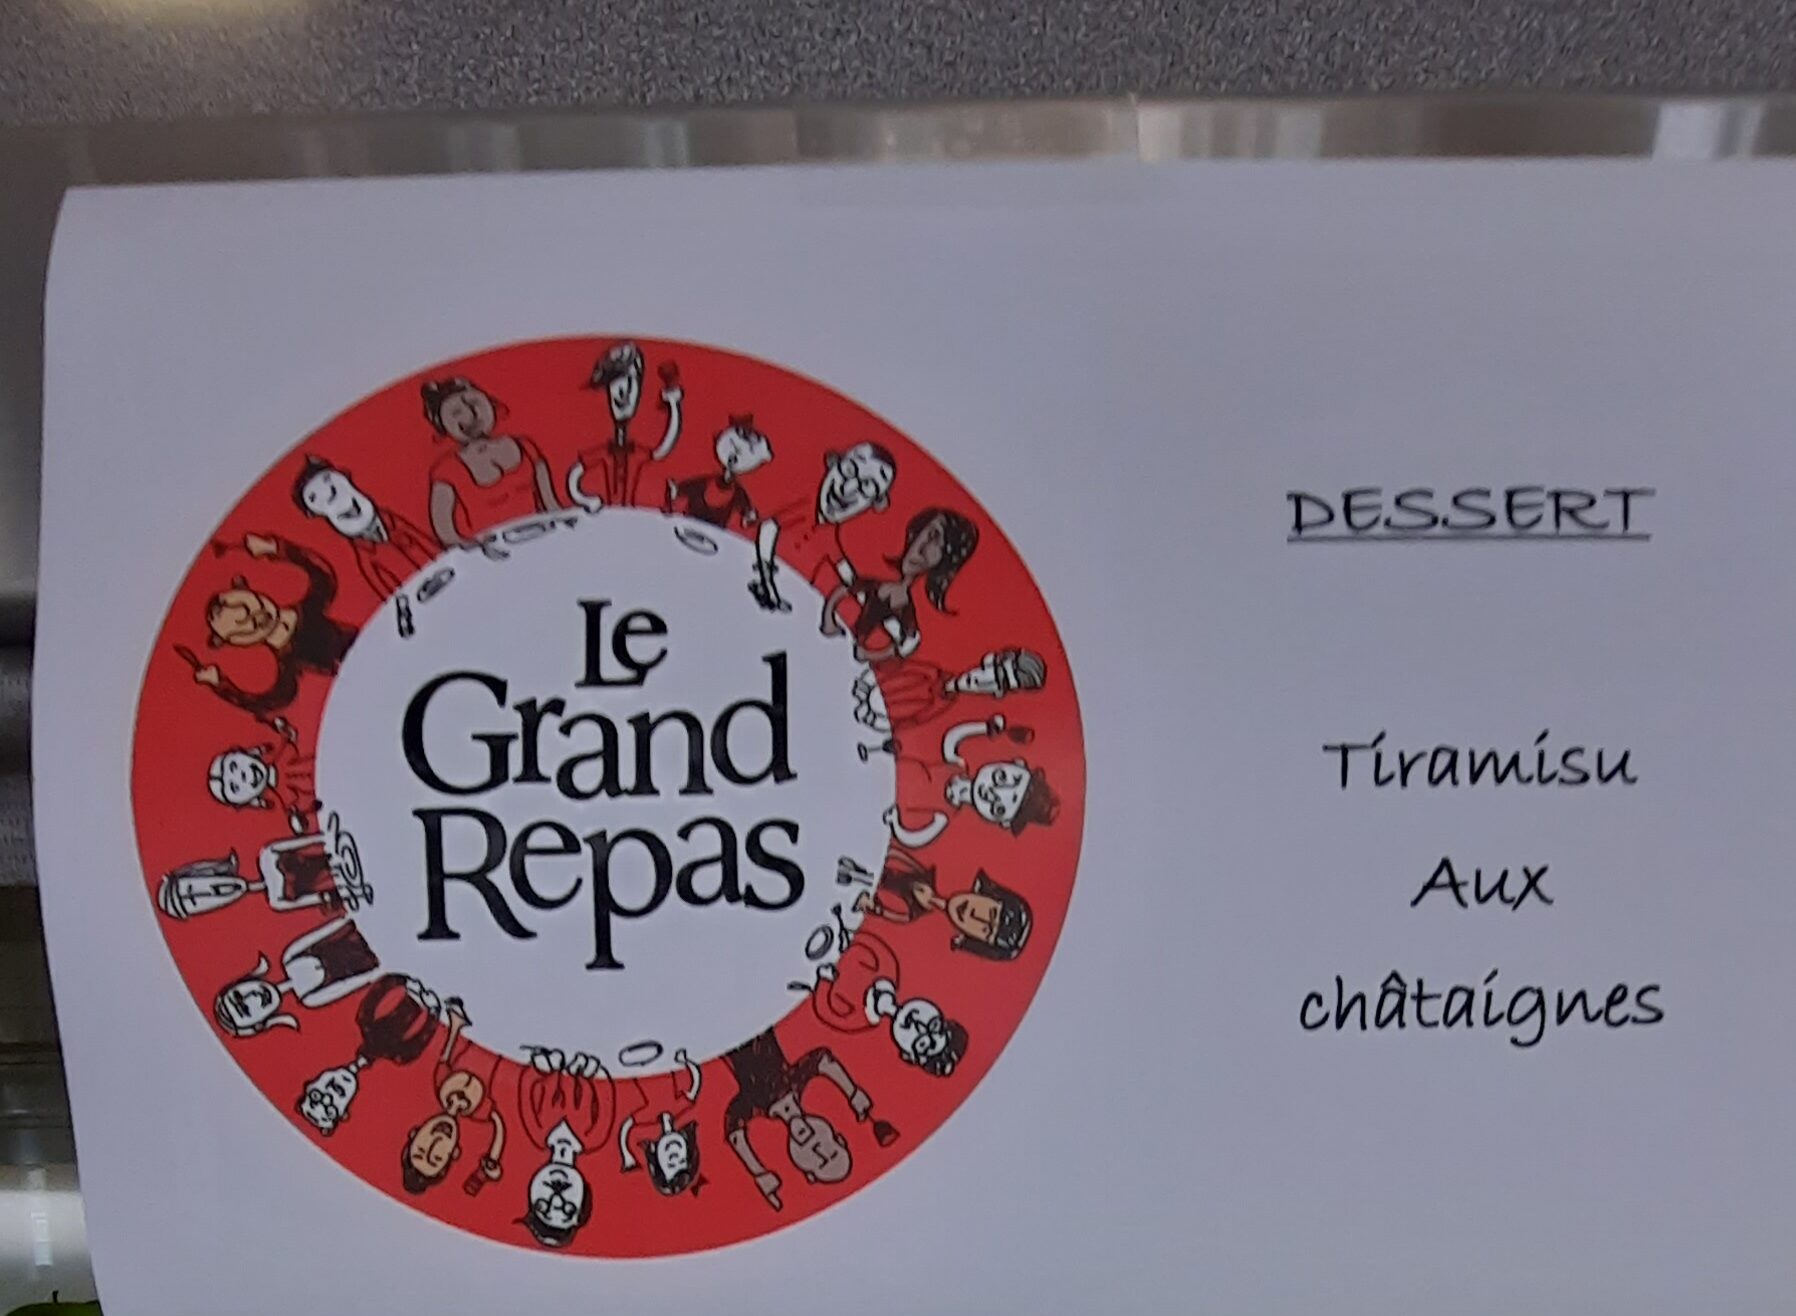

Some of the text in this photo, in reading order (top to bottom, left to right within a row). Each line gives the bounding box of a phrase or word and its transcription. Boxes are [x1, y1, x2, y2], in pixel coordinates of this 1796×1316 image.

[1286, 486, 1655, 536] DESSERT
[574, 600, 668, 689] Le
[401, 650, 798, 799] Grand
[1322, 729, 1638, 789] Tiramisu
[411, 807, 805, 971] Repas
[1410, 857, 1555, 911] Aux
[1299, 969, 1666, 1048] châtaignes
